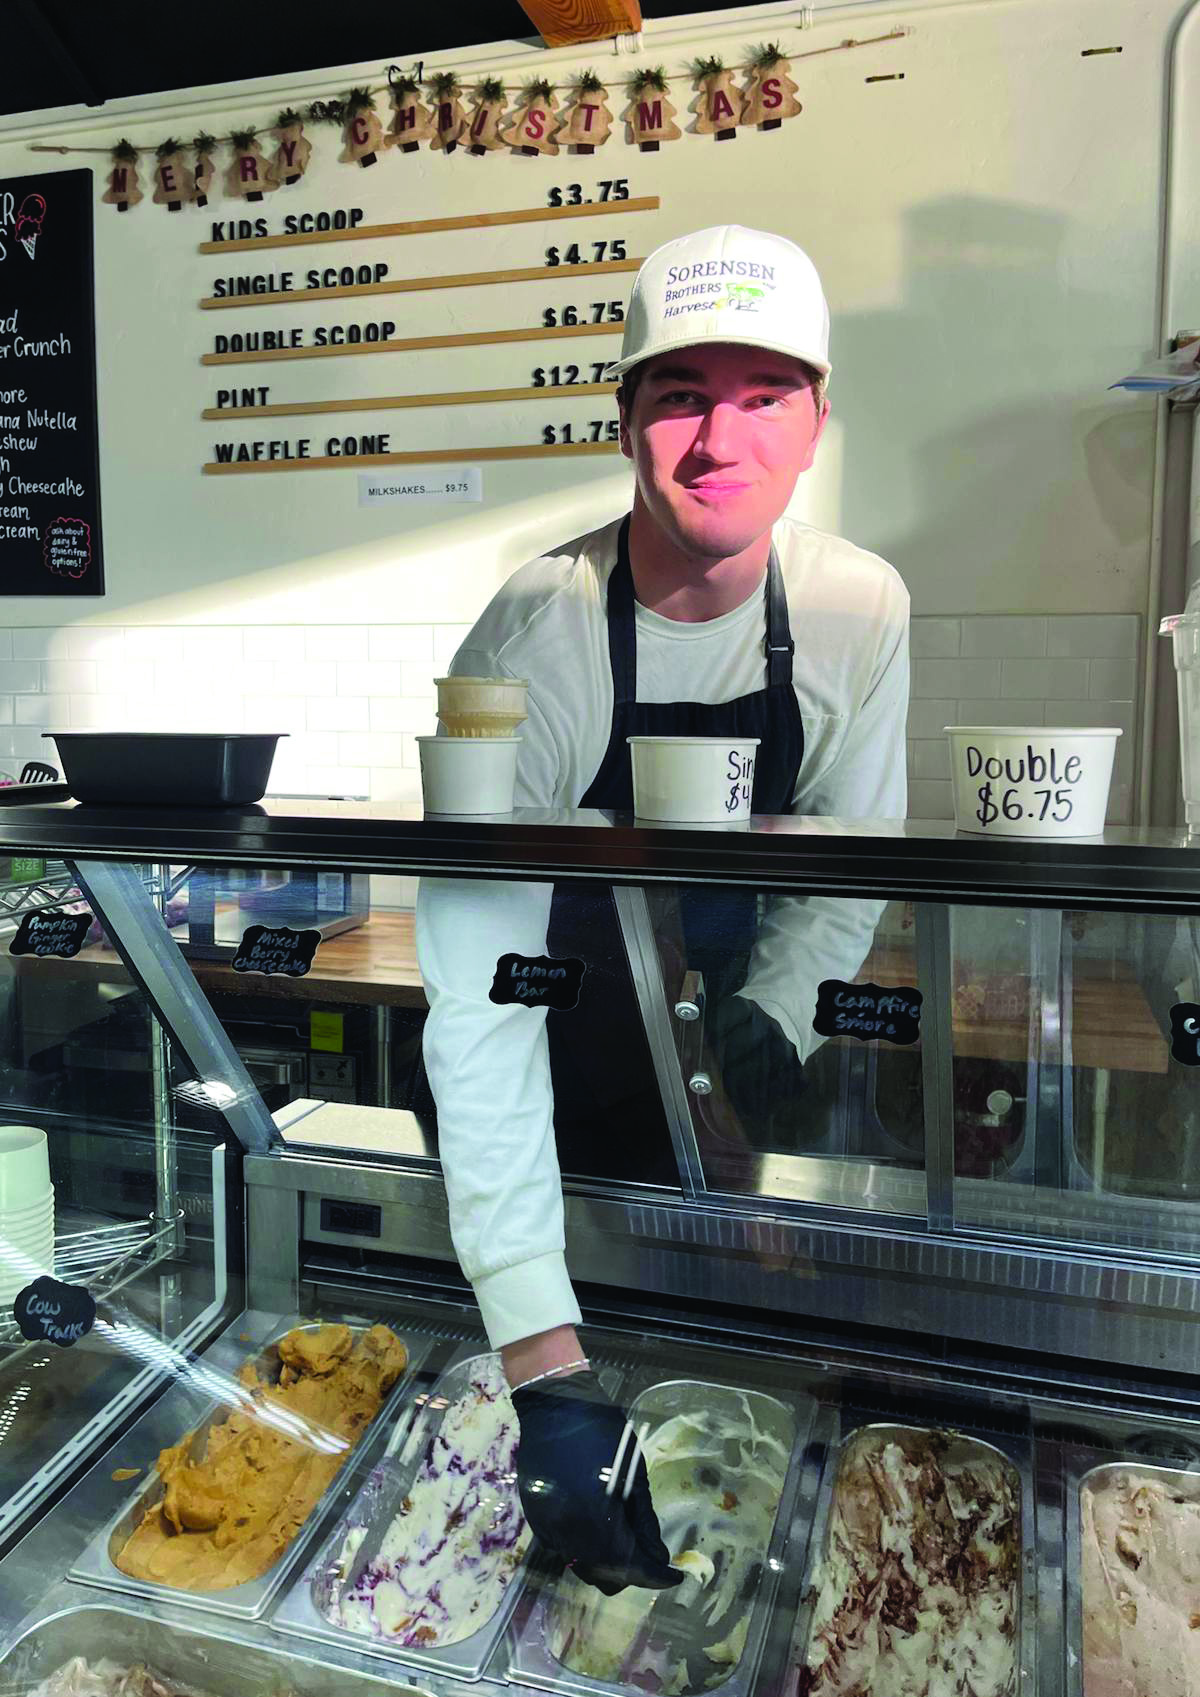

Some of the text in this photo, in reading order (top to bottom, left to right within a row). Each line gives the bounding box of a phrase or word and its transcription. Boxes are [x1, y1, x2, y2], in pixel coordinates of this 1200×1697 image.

[352, 79, 783, 145] CHRISTMAS
[0, 191, 16, 226] R
[212, 179, 629, 242] KIDS SCOOP $3.75
[213, 240, 626, 298] SINGLE SCOOP $4.75
[667, 260, 775, 285] SORENSEN
[665, 282, 722, 302] BROTHERS
[214, 301, 624, 354] DOUBLE SCOOP $6.75
[14, 332, 72, 358] Crunch
[216, 386, 270, 409] PINT
[27, 408, 77, 430] Nutella
[0, 433, 38, 451] shew
[215, 420, 619, 464] WAFFLE CONE $1.75
[9, 476, 85, 496] Cheesecake
[445, 483, 468, 493] $9.75
[64, 527, 84, 536] about
[72, 536, 78, 546] &
[966, 745, 1083, 785] Double
[976, 782, 1074, 828] $6.75
[15, 861, 40, 872] SIZE
[257, 932, 300, 949] Mixed
[251, 945, 290, 961] Berry
[511, 962, 567, 978] Lemon
[515, 981, 549, 998] Bar
[26, 1294, 61, 1315] Cow
